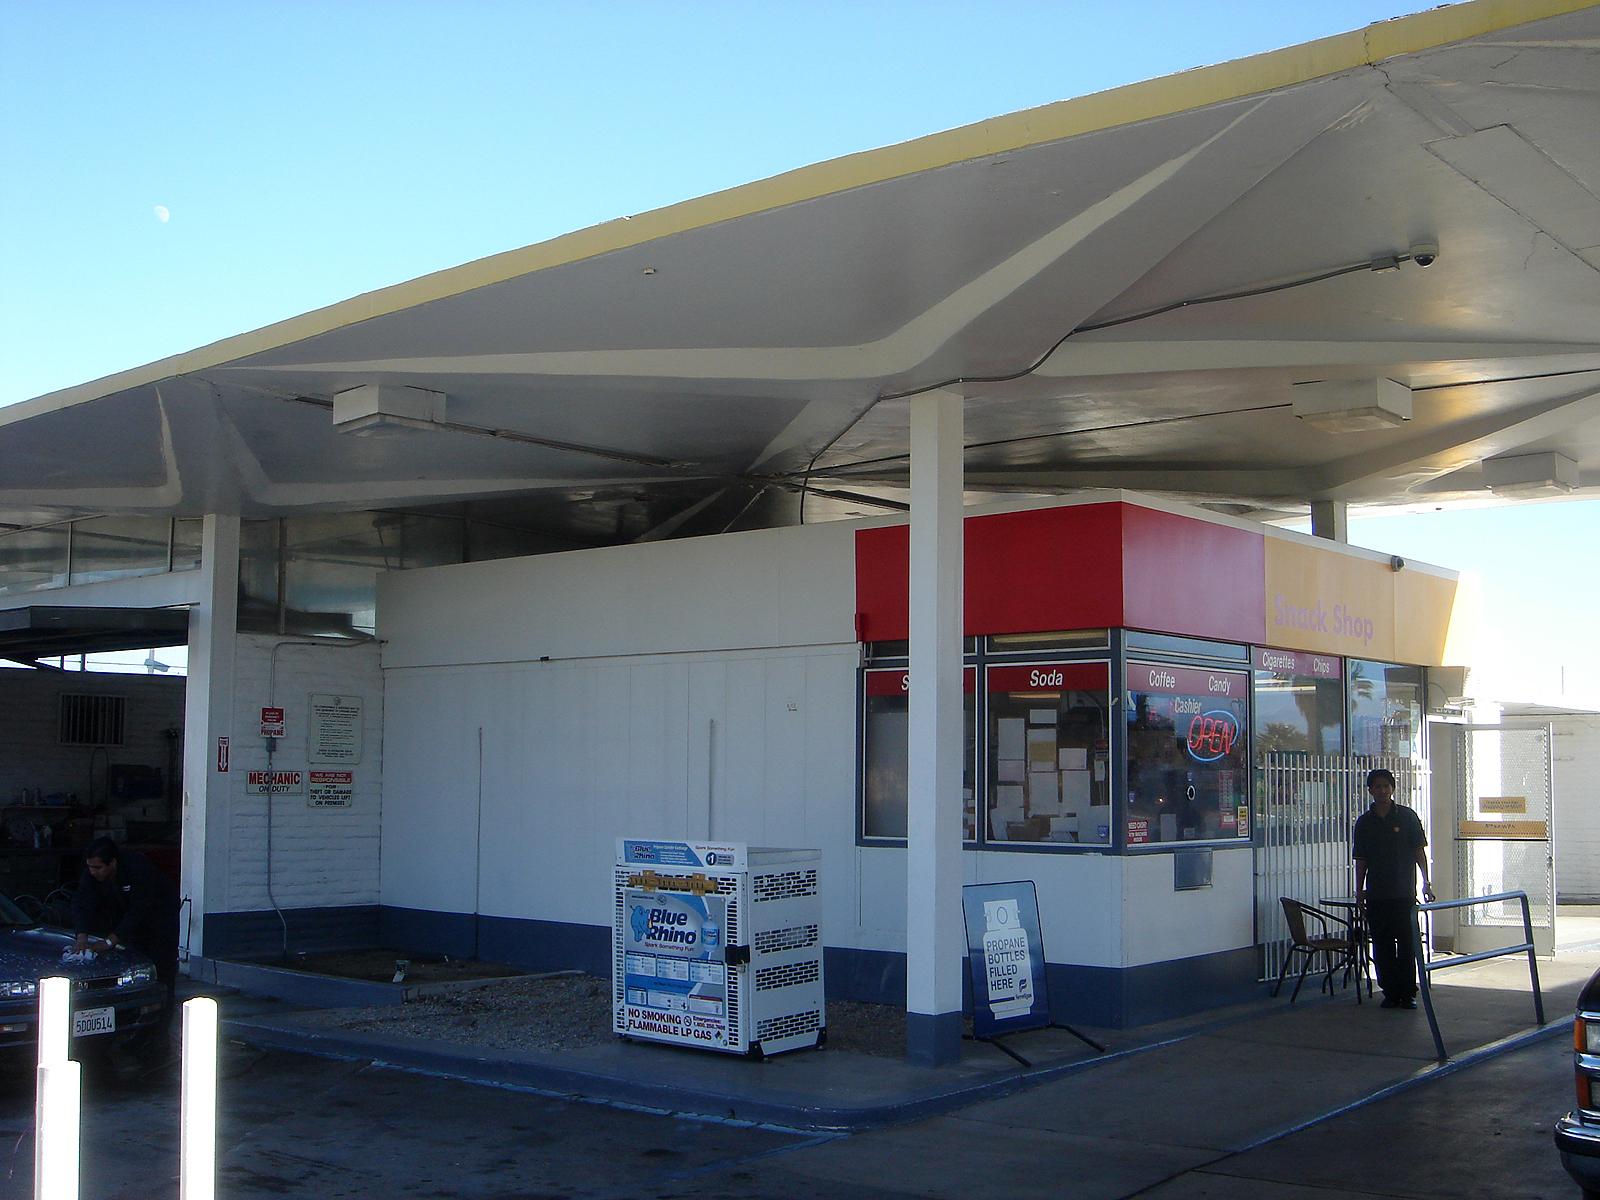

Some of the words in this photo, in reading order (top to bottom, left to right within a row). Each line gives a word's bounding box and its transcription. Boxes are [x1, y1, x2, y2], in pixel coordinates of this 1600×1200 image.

[1275, 594, 1328, 632] Snack
[1333, 604, 1374, 647] Shop
[1262, 651, 1295, 670] Cigarettes
[1313, 657, 1330, 675] Chips
[1029, 669, 1064, 687] Soda
[1149, 669, 1176, 689] Coffee
[1208, 675, 1232, 695] Candy
[1174, 696, 1202, 714] Cashier
[260, 728, 285, 737] PROPANE
[1188, 715, 1236, 754] OPEN
[248, 772, 301, 785] MECHANIC
[258, 785, 270, 793] ON
[271, 785, 291, 793] DUTY
[634, 845, 651, 853] Blue
[634, 852, 655, 860] Rhino
[650, 908, 688, 926] Blue
[646, 925, 697, 944] Rhino
[658, 942, 684, 952] Something
[986, 937, 1026, 951] PROPANE
[988, 950, 1026, 964] BOTTLES
[990, 964, 1018, 978] FILLED
[991, 977, 1014, 991] HERE
[628, 1008, 640, 1018] NO
[641, 1010, 682, 1025] SMOKING
[628, 1019, 679, 1036] FLAMMABLE
[680, 1027, 692, 1037] LP
[693, 1029, 712, 1040] GAS
